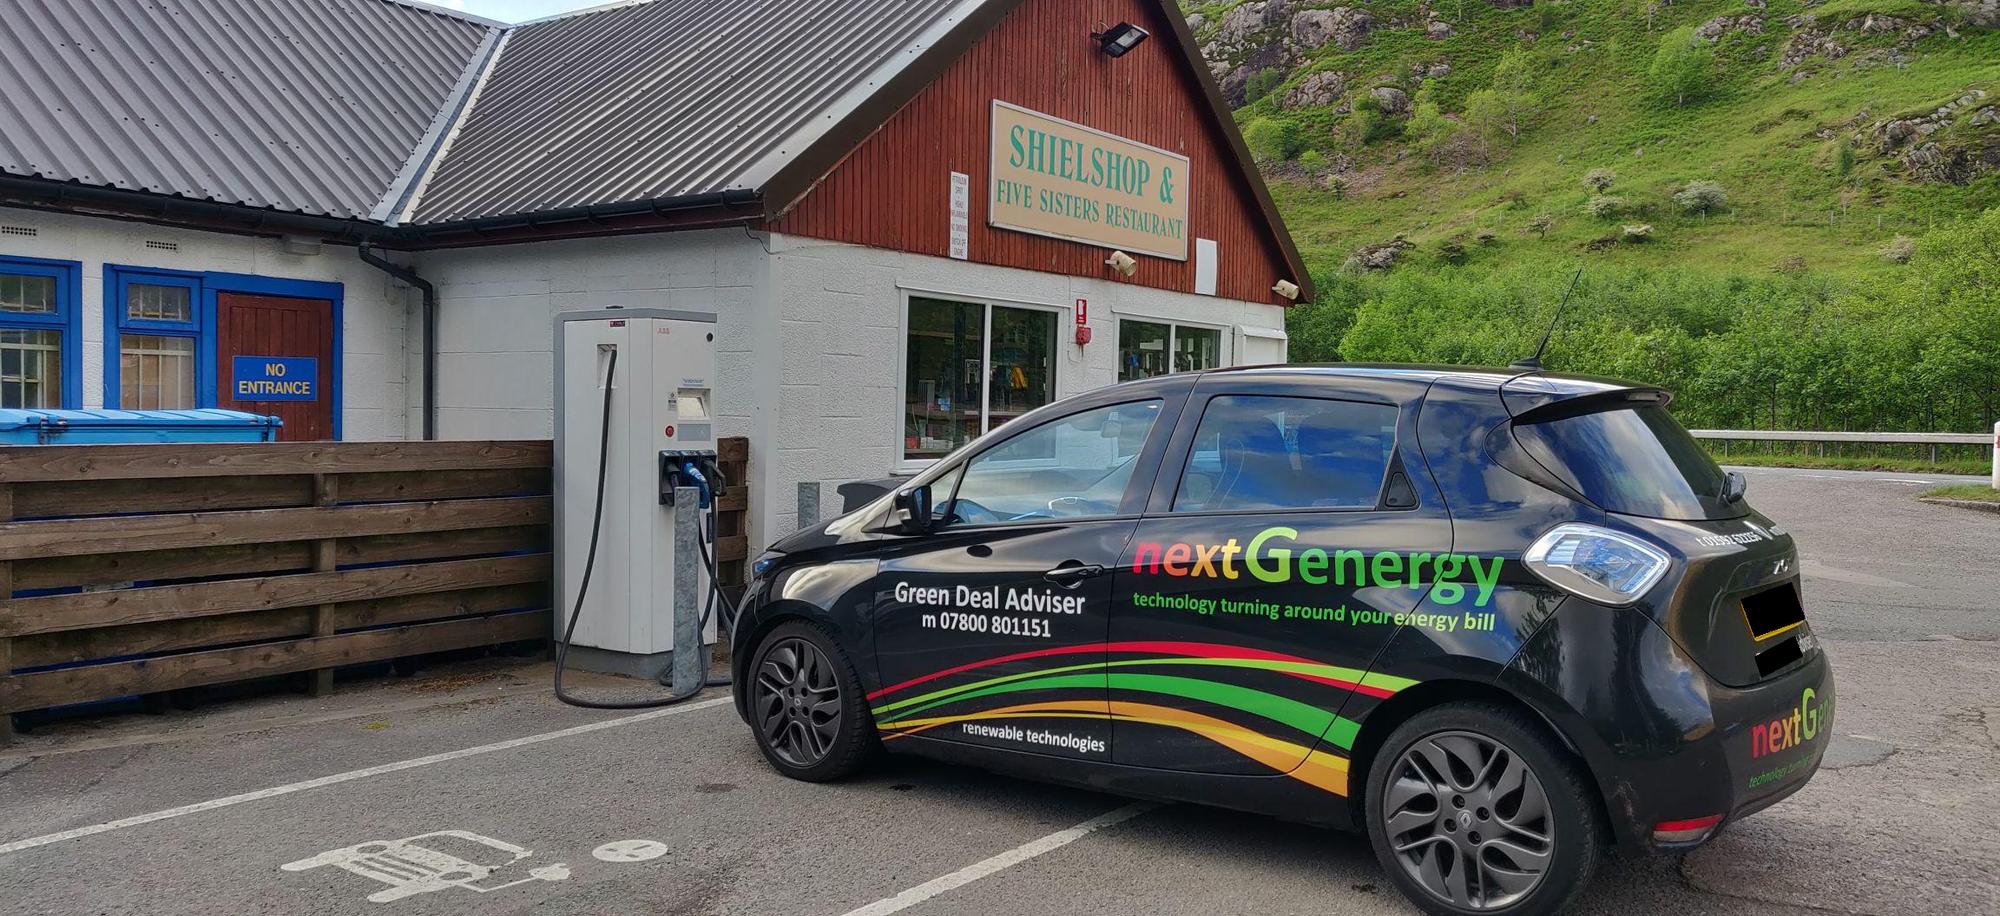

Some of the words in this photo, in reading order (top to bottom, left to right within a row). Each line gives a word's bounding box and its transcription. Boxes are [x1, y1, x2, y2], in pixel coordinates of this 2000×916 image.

[1009, 124, 1150, 197] SHIELSHOP
[1159, 166, 1174, 205] &
[997, 179, 1032, 209] FIVE
[1040, 189, 1099, 224] SISTERS
[1106, 203, 1183, 240] RESTAURANT
[265, 363, 286, 377] NO
[238, 380, 311, 395] ENTRANCE
[895, 581, 950, 606] Green
[956, 585, 999, 610] Deal
[1005, 588, 1086, 615] Adviser
[1133, 592, 1216, 615] technology
[1220, 598, 1280, 620] turning
[1284, 604, 1345, 622] around
[1351, 610, 1390, 626] your
[1394, 612, 1459, 632] energy
[1464, 612, 1494, 632] bill
[922, 615, 936, 628] m
[940, 612, 987, 632] 07800
[991, 616, 1051, 638] 801151
[963, 722, 1024, 742] renewable
[1026, 729, 1105, 753] technologies
